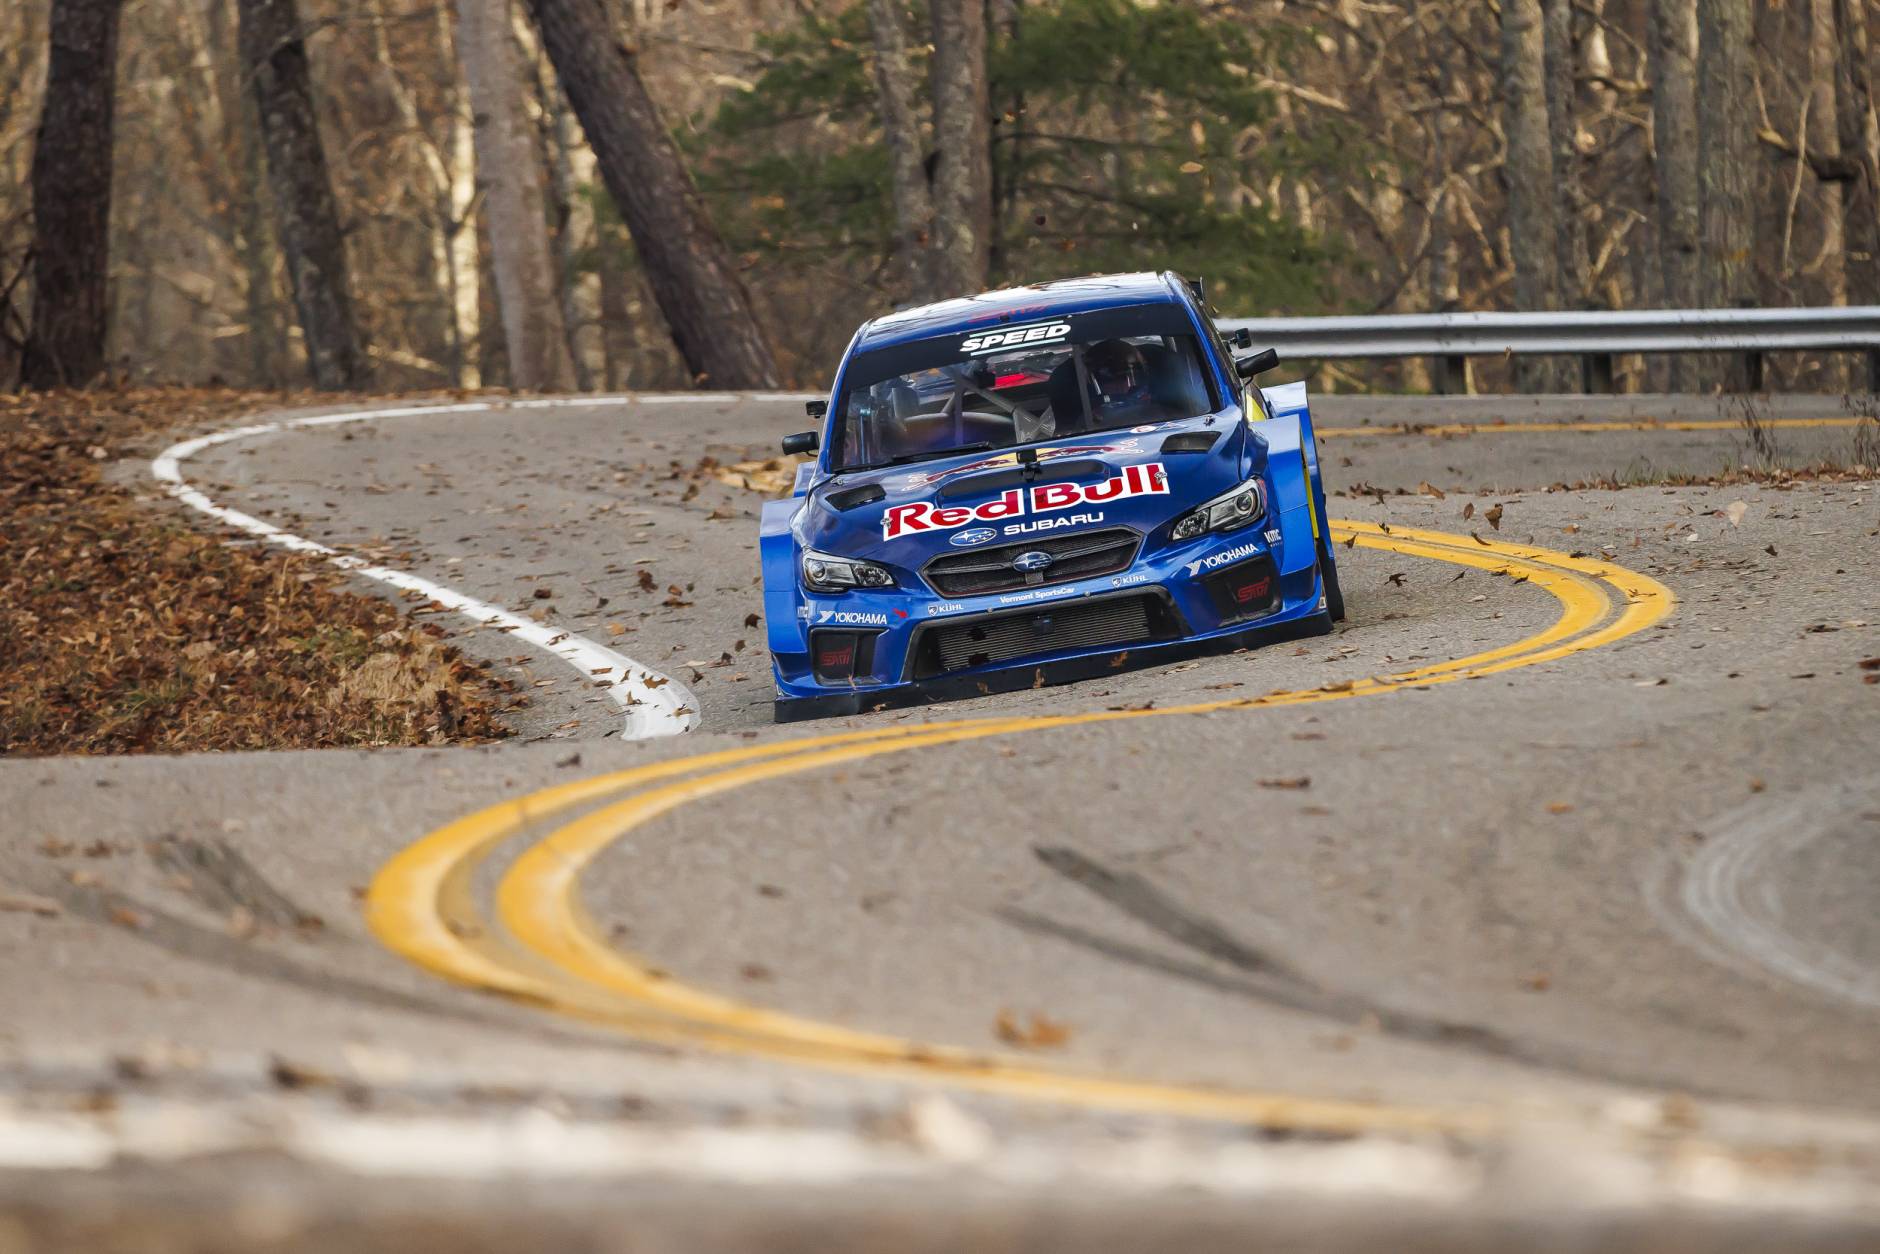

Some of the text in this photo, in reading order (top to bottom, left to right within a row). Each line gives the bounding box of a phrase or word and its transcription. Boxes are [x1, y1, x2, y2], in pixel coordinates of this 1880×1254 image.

[960, 324, 1071, 352] SPEED
[883, 462, 1170, 541] Red Bull
[1003, 512, 1104, 535] SUBARU
[1203, 543, 1259, 568] YOKOHAMA
[1000, 587, 1075, 604] Vermont SportsCar
[834, 612, 887, 625] YOKOHAMA
